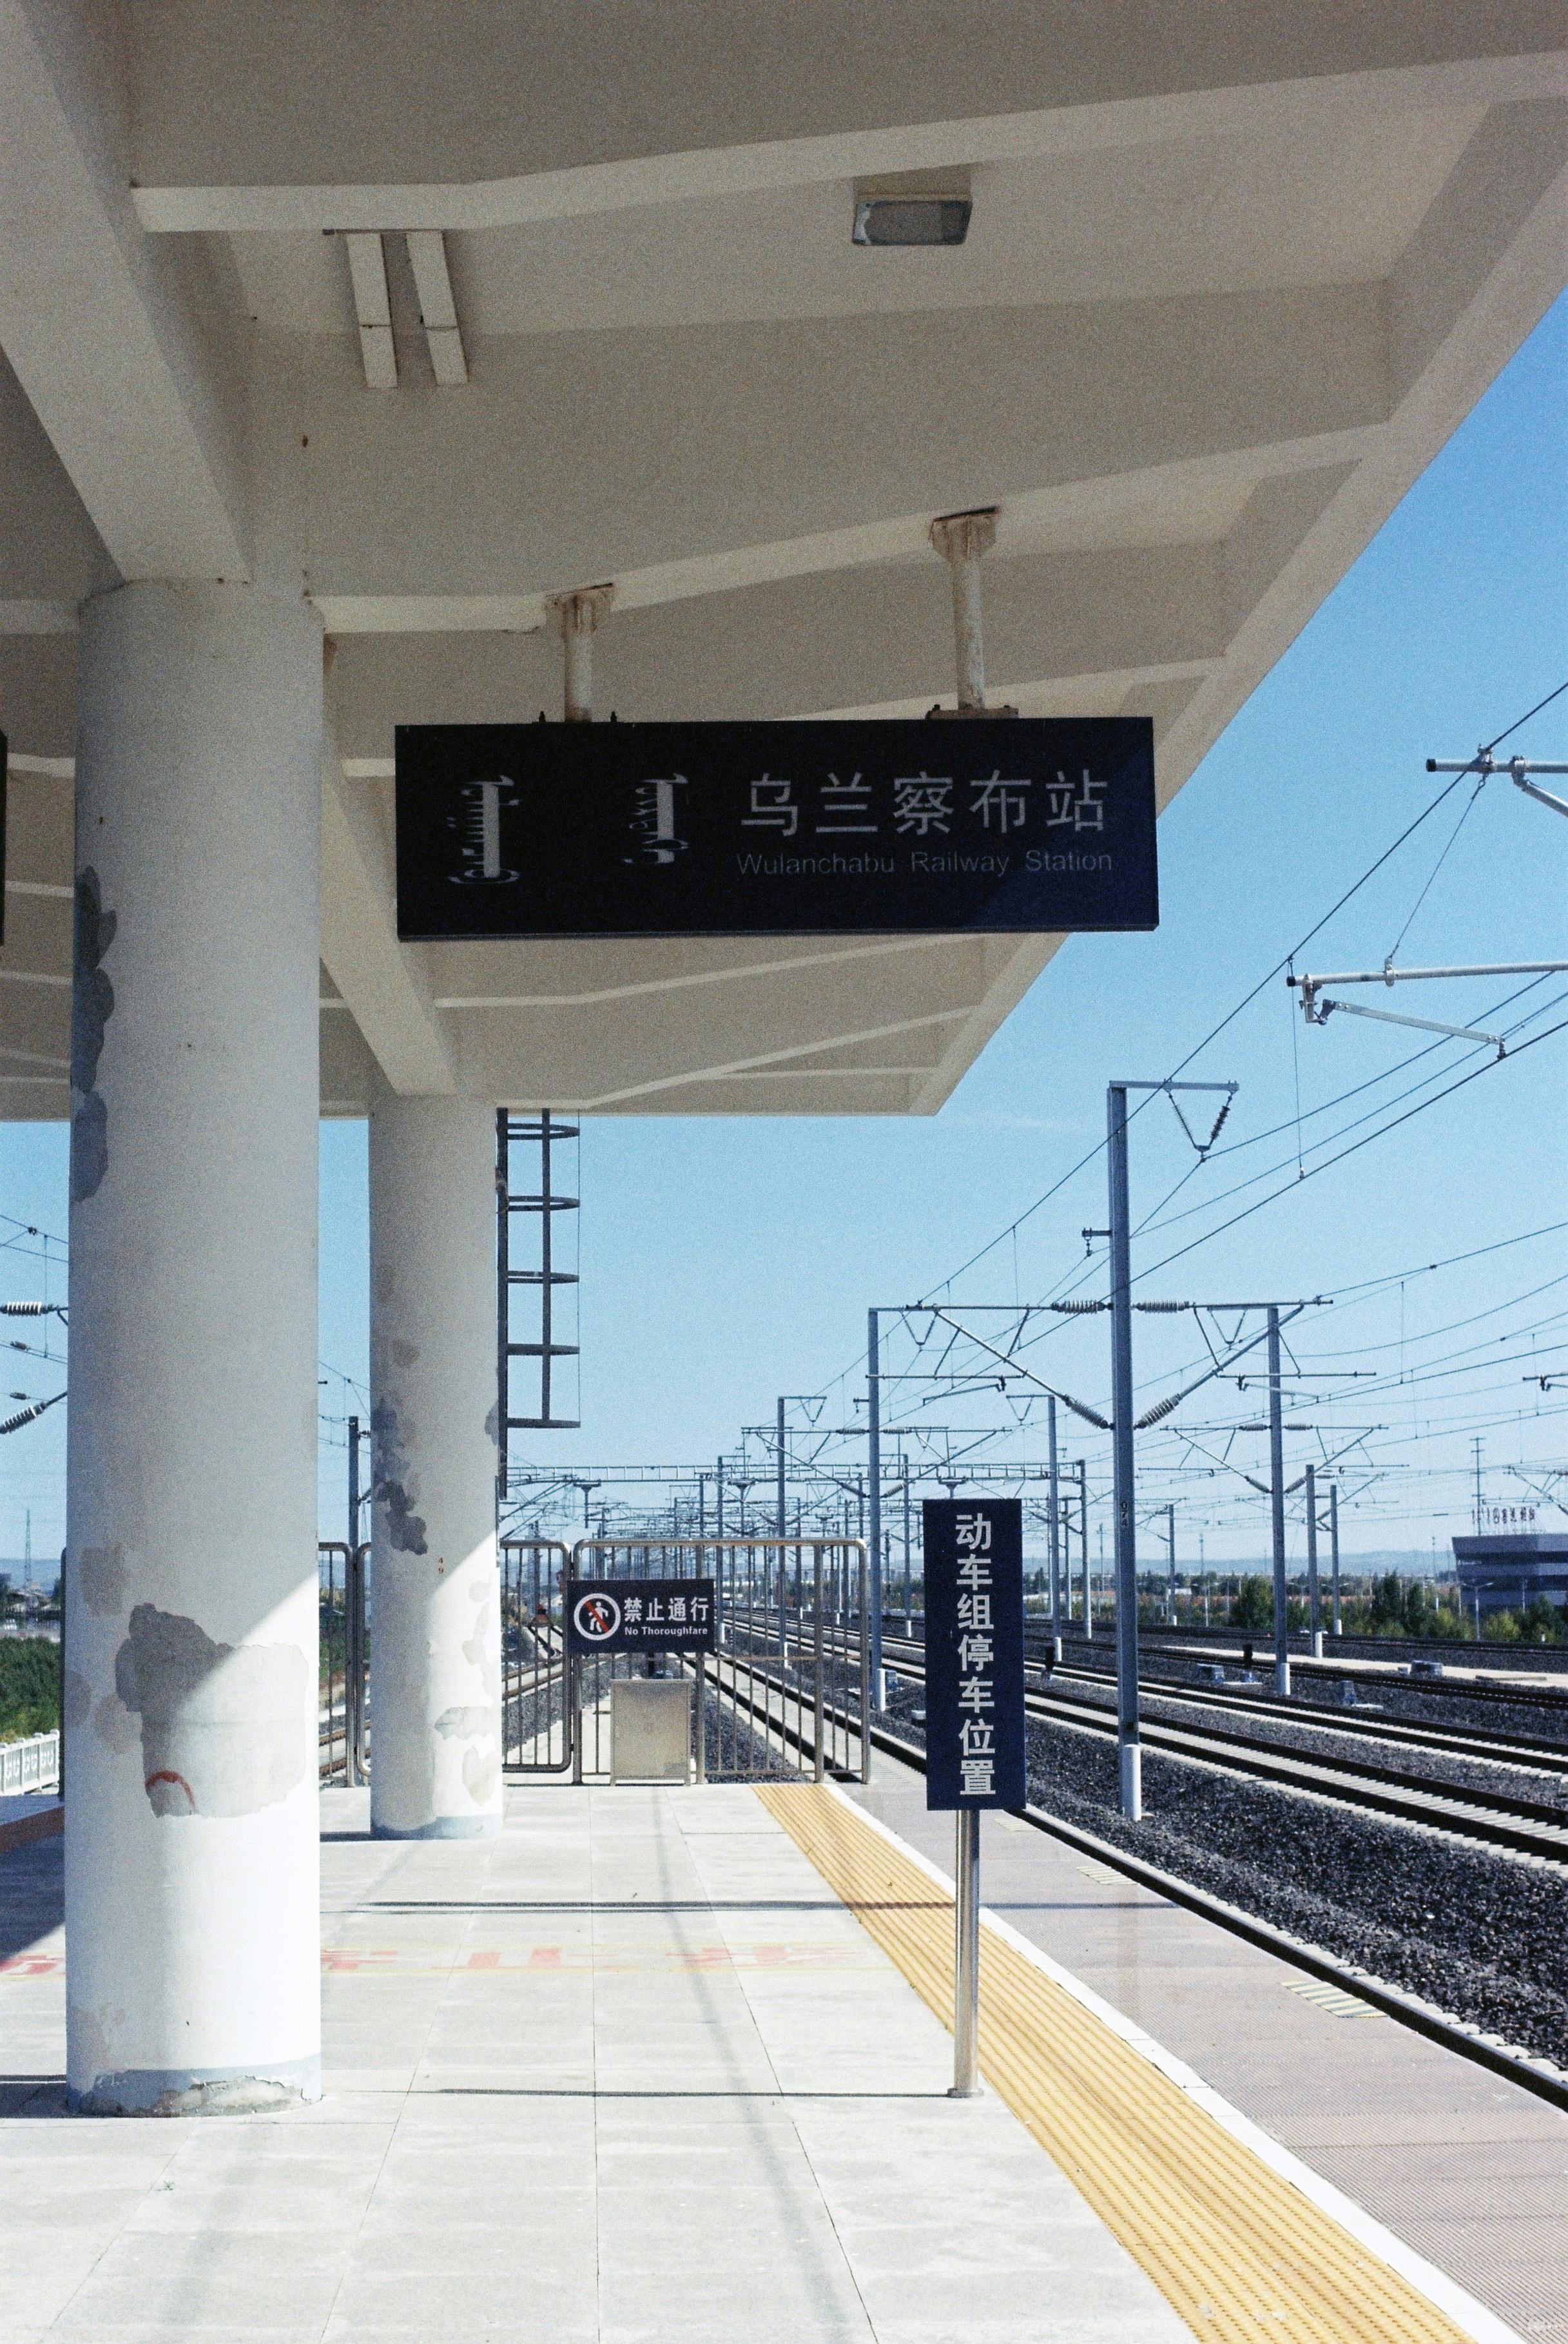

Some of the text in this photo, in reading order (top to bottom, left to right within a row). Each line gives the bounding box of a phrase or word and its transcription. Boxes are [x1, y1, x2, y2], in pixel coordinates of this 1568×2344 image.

[741, 769, 1108, 837] 乌兰察布站
[736, 849, 1112, 877] Wulanchabu Railway Station
[624, 1596, 709, 1623] 禁止通行
[624, 1625, 708, 1638] No Thoroughfare
[955, 1512, 996, 1796] 动车组停车位置
